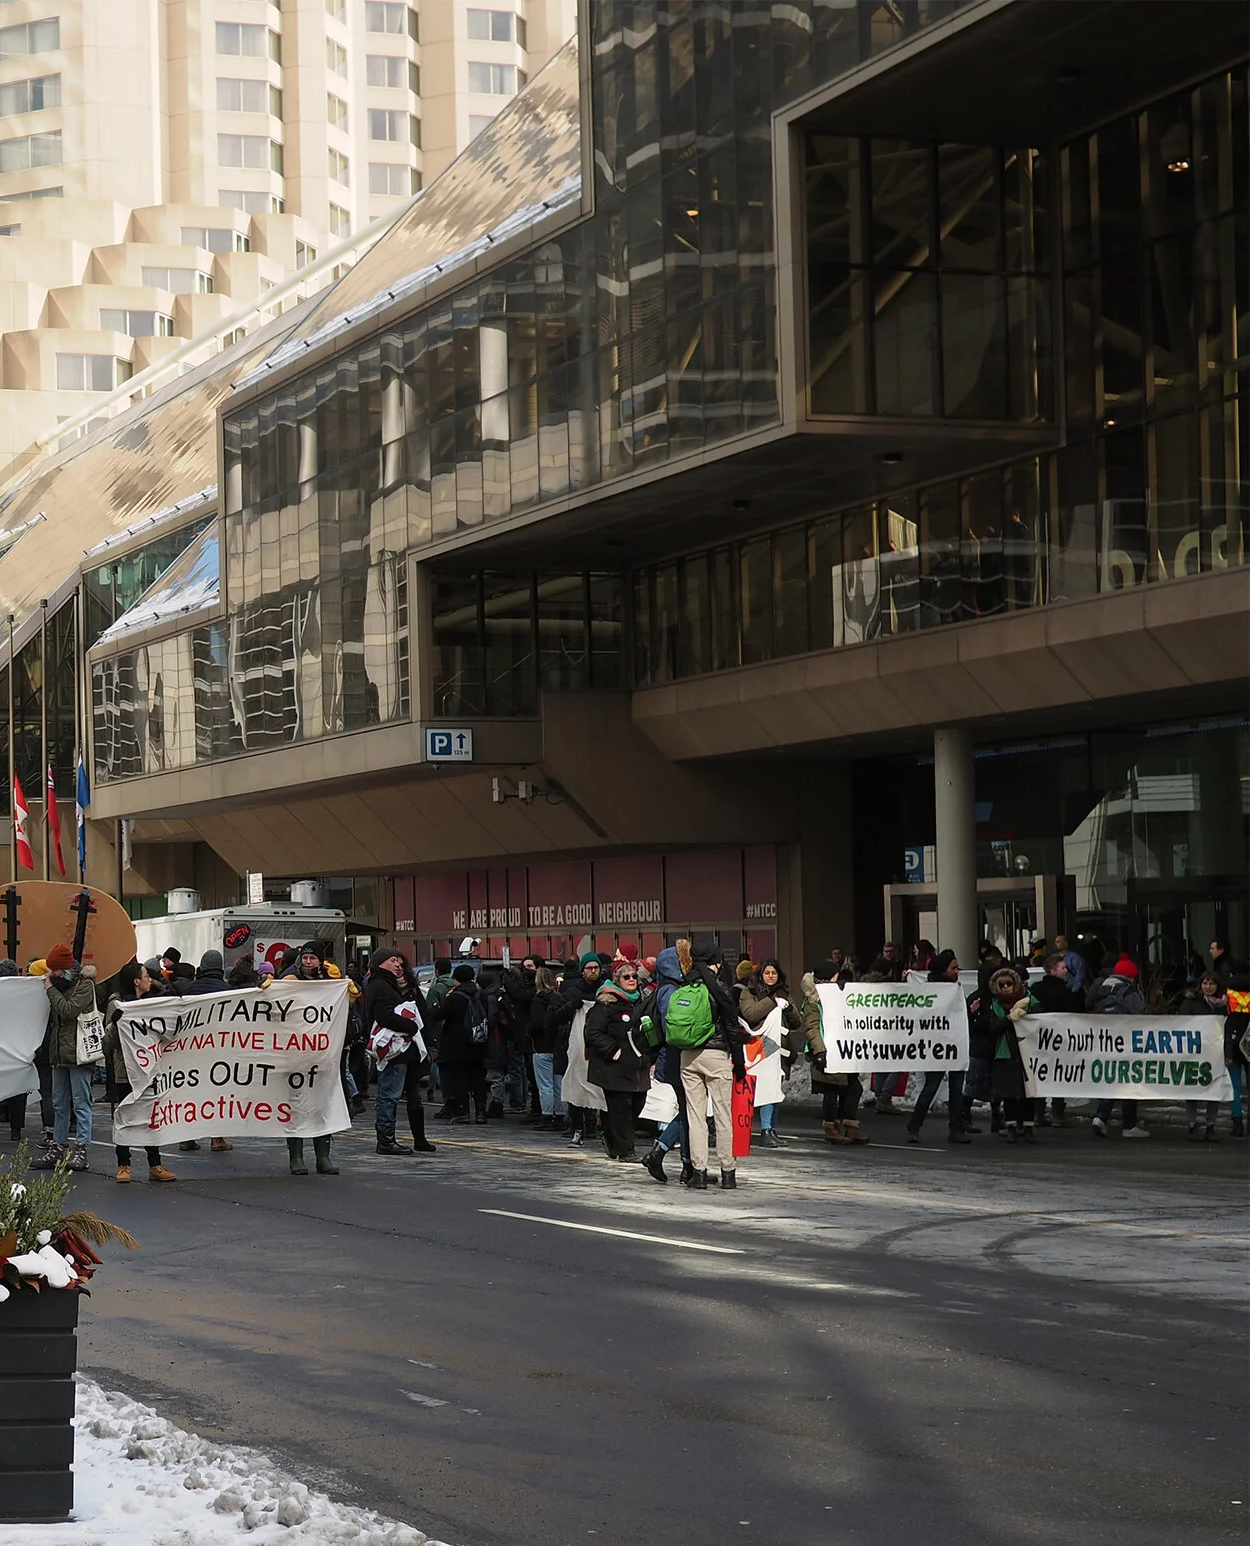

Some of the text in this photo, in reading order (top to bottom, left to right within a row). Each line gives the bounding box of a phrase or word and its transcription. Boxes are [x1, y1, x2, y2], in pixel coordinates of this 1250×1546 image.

[434, 735, 448, 753] P
[453, 900, 661, 930] WE ARE PROUD TO BE A GOOD NEIGHBOUR
[746, 903, 776, 918] #MTCC
[225, 925, 250, 947] OPEN
[395, 920, 414, 931] #MTCC
[845, 993, 938, 1009] GREENPEACE
[129, 1016, 167, 1040] NO
[173, 999, 294, 1036] MILITARY
[303, 1005, 333, 1024] ON
[843, 1015, 950, 1036] in solidarity with
[136, 1031, 330, 1067] STEN NATIVE LAND
[836, 1039, 958, 1060] Wet'suwet'en
[1038, 1027, 1202, 1054] We hurt the EARTH
[209, 1061, 275, 1087] OUT
[288, 1065, 319, 1090] of
[1054, 1058, 1085, 1083] hurt
[1091, 1059, 1213, 1086] OURSELVES
[149, 1094, 293, 1130] Extractives
